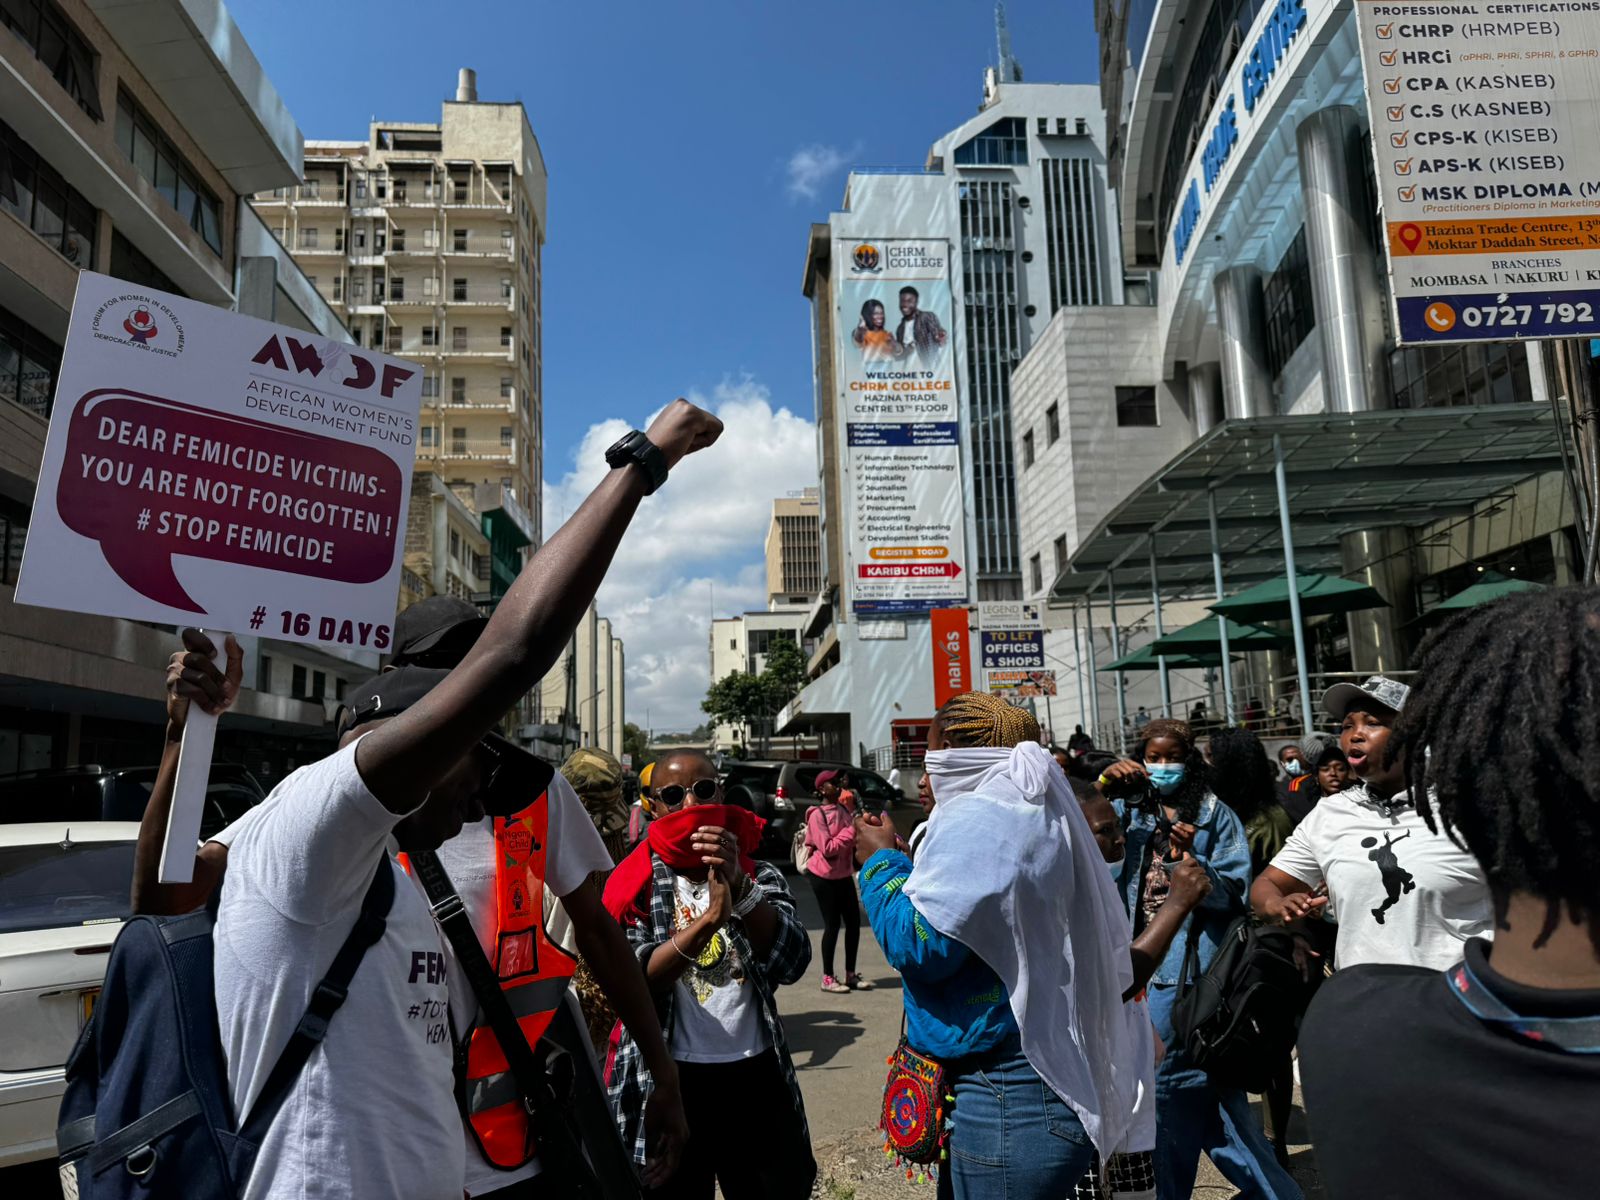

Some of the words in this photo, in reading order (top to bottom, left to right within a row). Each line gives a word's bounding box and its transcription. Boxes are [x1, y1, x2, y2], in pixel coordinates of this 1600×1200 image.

[1373, 6, 1479, 16] PROFESSIONAL
[1487, 2, 1600, 14] CERTIFICATIONS
[1399, 24, 1454, 38] CHRP
[1462, 21, 1560, 39] (HRMPEB)
[1402, 49, 1452, 64] HRCi
[1559, 50, 1565, 58] &
[1568, 49, 1599, 58] GPHR)
[1406, 77, 1449, 91] CPA
[1456, 74, 1555, 92] (KASNEB)
[1410, 104, 1444, 118] C.S
[1451, 101, 1551, 119] (KASNEB)
[1414, 130, 1478, 145] CPS-K
[1484, 128, 1558, 146] (KISEB)
[1418, 158, 1482, 173] APS-K
[1489, 155, 1564, 174] (KISEB)
[1422, 186, 1468, 201] MSK
[1474, 182, 1572, 200] DIPLOMA
[1422, 202, 1491, 214] (Practitioners
[1493, 201, 1536, 212] Diploma
[1538, 200, 1548, 209] in
[1550, 199, 1600, 209] Marketing
[1425, 225, 1474, 237] Hazina
[1477, 223, 1518, 235] Trade
[1521, 221, 1573, 234] Centre,
[1428, 238, 1478, 250] Moktar
[1482, 235, 1536, 249] Daddah
[1539, 233, 1584, 247] Street,
[890, 247, 925, 257] CHRM
[890, 258, 944, 268] COLLEGE
[1492, 258, 1562, 270] BRANCHES
[1411, 274, 1488, 288] MOMBASA
[1504, 271, 1569, 284] NAKURU
[92, 307, 106, 331] FORUM
[103, 297, 120, 309] FOR
[119, 294, 151, 304] WOMEN
[151, 299, 160, 307] IN
[1463, 305, 1532, 327] 0727
[1540, 302, 1594, 325] 792
[94, 332, 136, 348] DEMOCRACY
[136, 342, 151, 351] AND
[151, 347, 178, 358] JUSTICE
[866, 371, 917, 380] WELCOME
[919, 371, 934, 380] TO
[850, 382, 888, 391] CHRM
[892, 381, 951, 391] COLLEGE
[864, 394, 902, 402] HAZINA
[904, 393, 938, 402] TRADE
[247, 380, 325, 409] AFRICAN
[333, 400, 414, 431] WOMEN'S
[854, 404, 893, 413] CENTRE
[915, 404, 949, 413] FLOOR
[245, 395, 366, 435] DEVELOPMENT
[368, 425, 413, 446] FUND
[98, 416, 166, 453] DEAR
[172, 433, 285, 477] FEMICIDE
[864, 464, 910, 472] Information
[911, 463, 955, 473] Technology
[865, 474, 906, 482] Hospitality
[80, 453, 134, 487] YOU
[138, 466, 189, 498] ARE
[193, 477, 244, 507] NOT
[247, 488, 381, 536] FORGOTTEN
[865, 484, 908, 492] Journalism
[866, 494, 905, 502] Marketing
[866, 504, 916, 512] Procurement
[866, 514, 911, 522] Accounting
[904, 523, 951, 532] Engineering
[157, 510, 220, 543] STOP
[226, 522, 336, 565] FEMICIDE
[867, 534, 919, 543] Development
[916, 548, 944, 556] TODAY
[867, 566, 909, 576] KARIBU
[911, 566, 945, 575] CHRM
[983, 605, 1020, 614] LEGEND
[281, 610, 310, 637] 16
[318, 615, 391, 649] DAYS
[990, 632, 1007, 641] TO
[1010, 631, 1034, 641] LET
[985, 643, 1039, 653] OFFICES
[985, 657, 994, 667] &
[998, 656, 1041, 667] SHOPS
